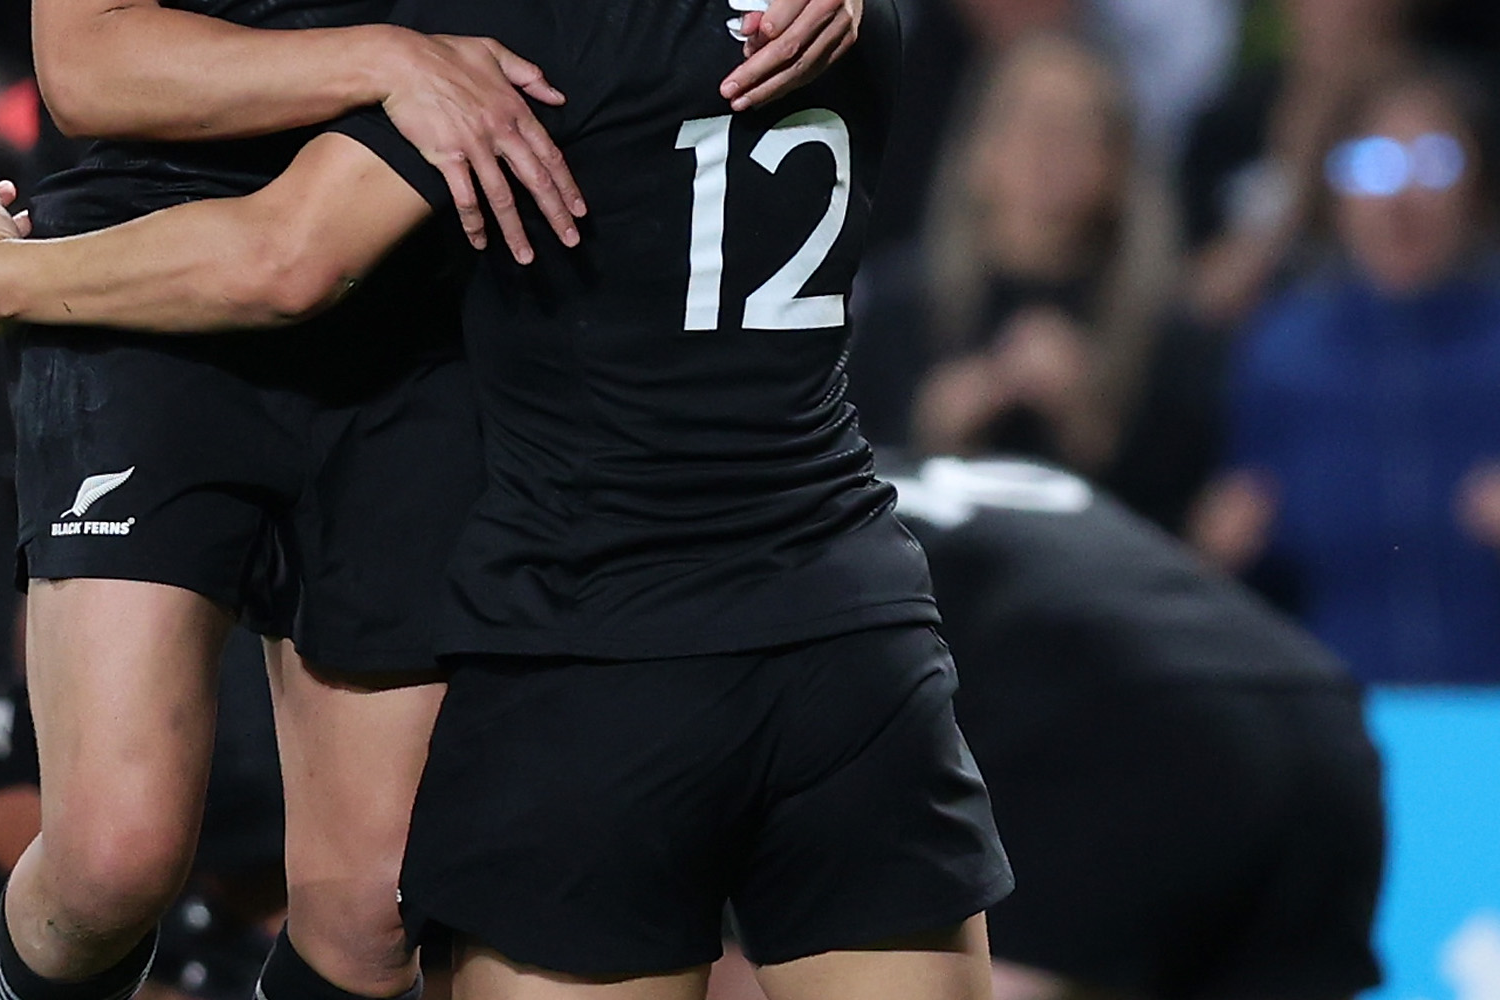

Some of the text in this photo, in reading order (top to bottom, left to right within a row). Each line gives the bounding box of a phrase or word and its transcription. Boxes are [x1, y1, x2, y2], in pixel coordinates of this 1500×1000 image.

[675, 108, 850, 331] 12
[51, 521, 130, 536] BLACK FERNS
